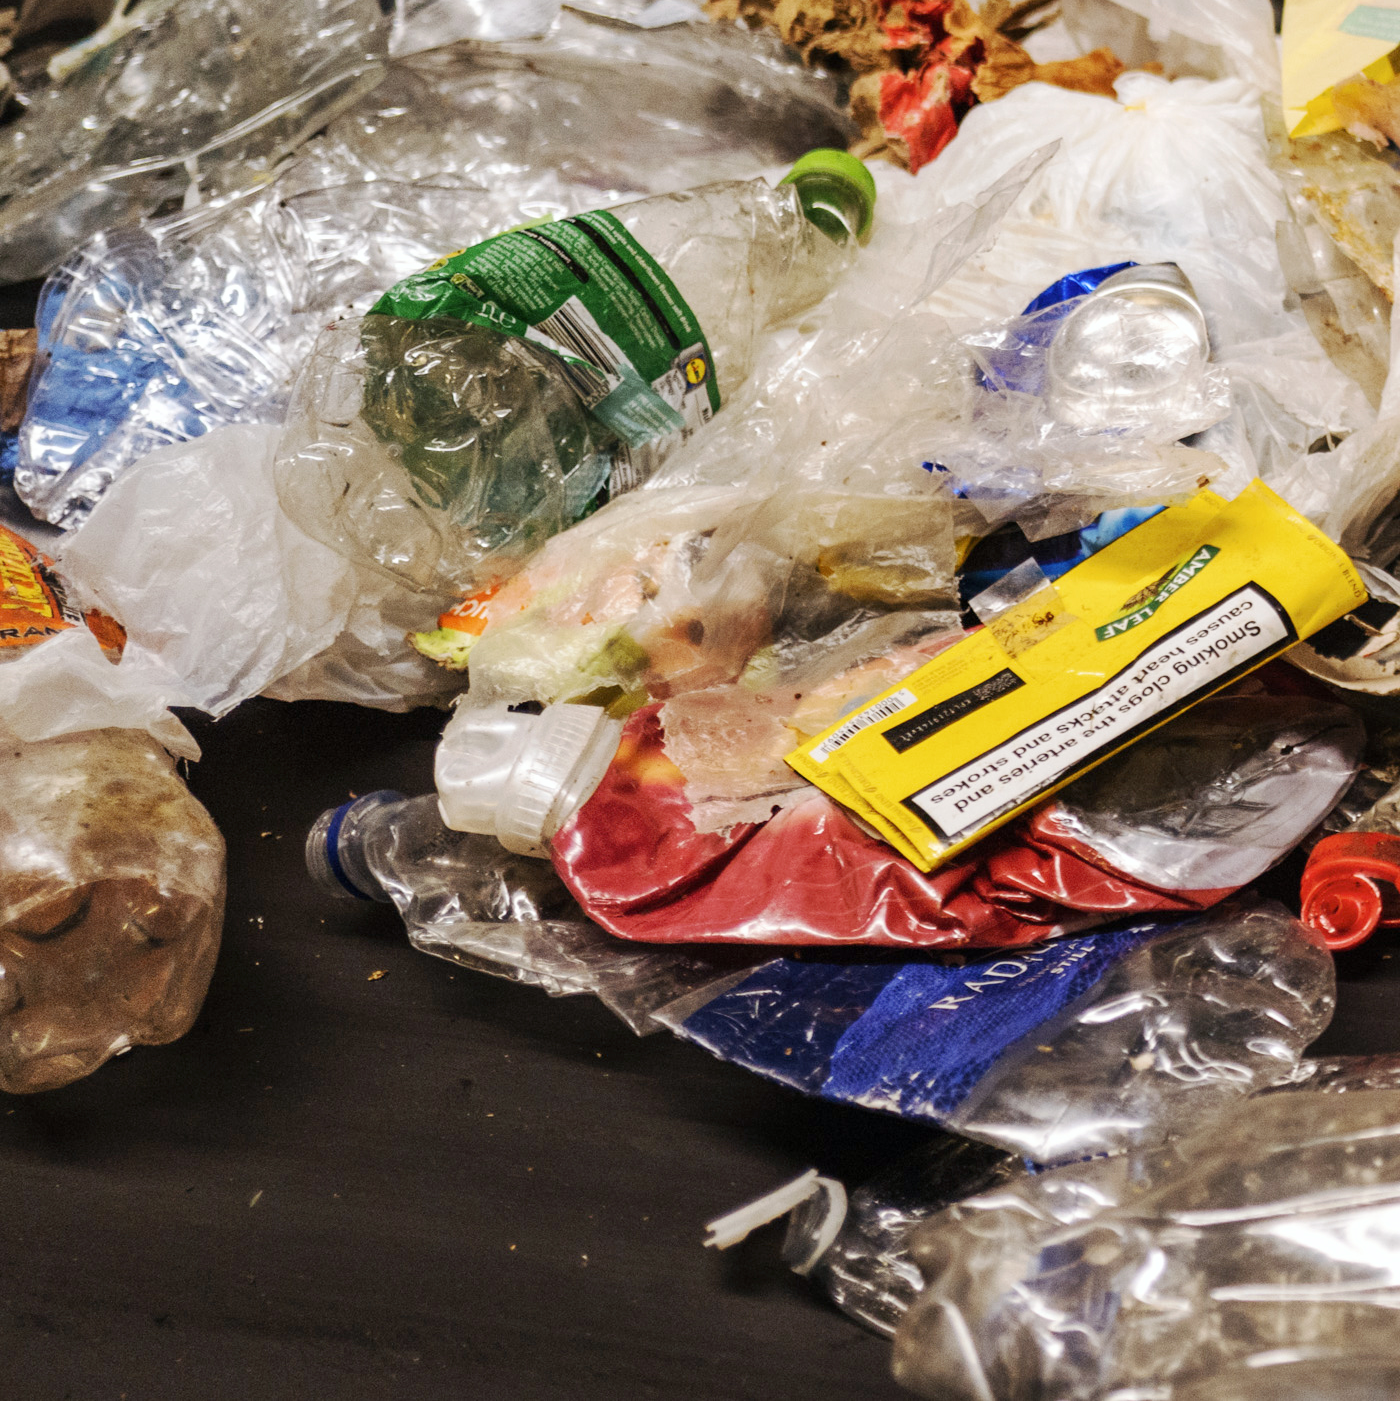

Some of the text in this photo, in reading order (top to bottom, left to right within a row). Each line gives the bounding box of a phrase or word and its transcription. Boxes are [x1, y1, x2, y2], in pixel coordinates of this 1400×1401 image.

[1104, 548, 1211, 639] AMBER LEAF
[930, 601, 1253, 804] causes heart attacks and strokes
[954, 620, 1261, 813] Smoking clogs the arteries and
[1051, 946, 1096, 974] STILL
